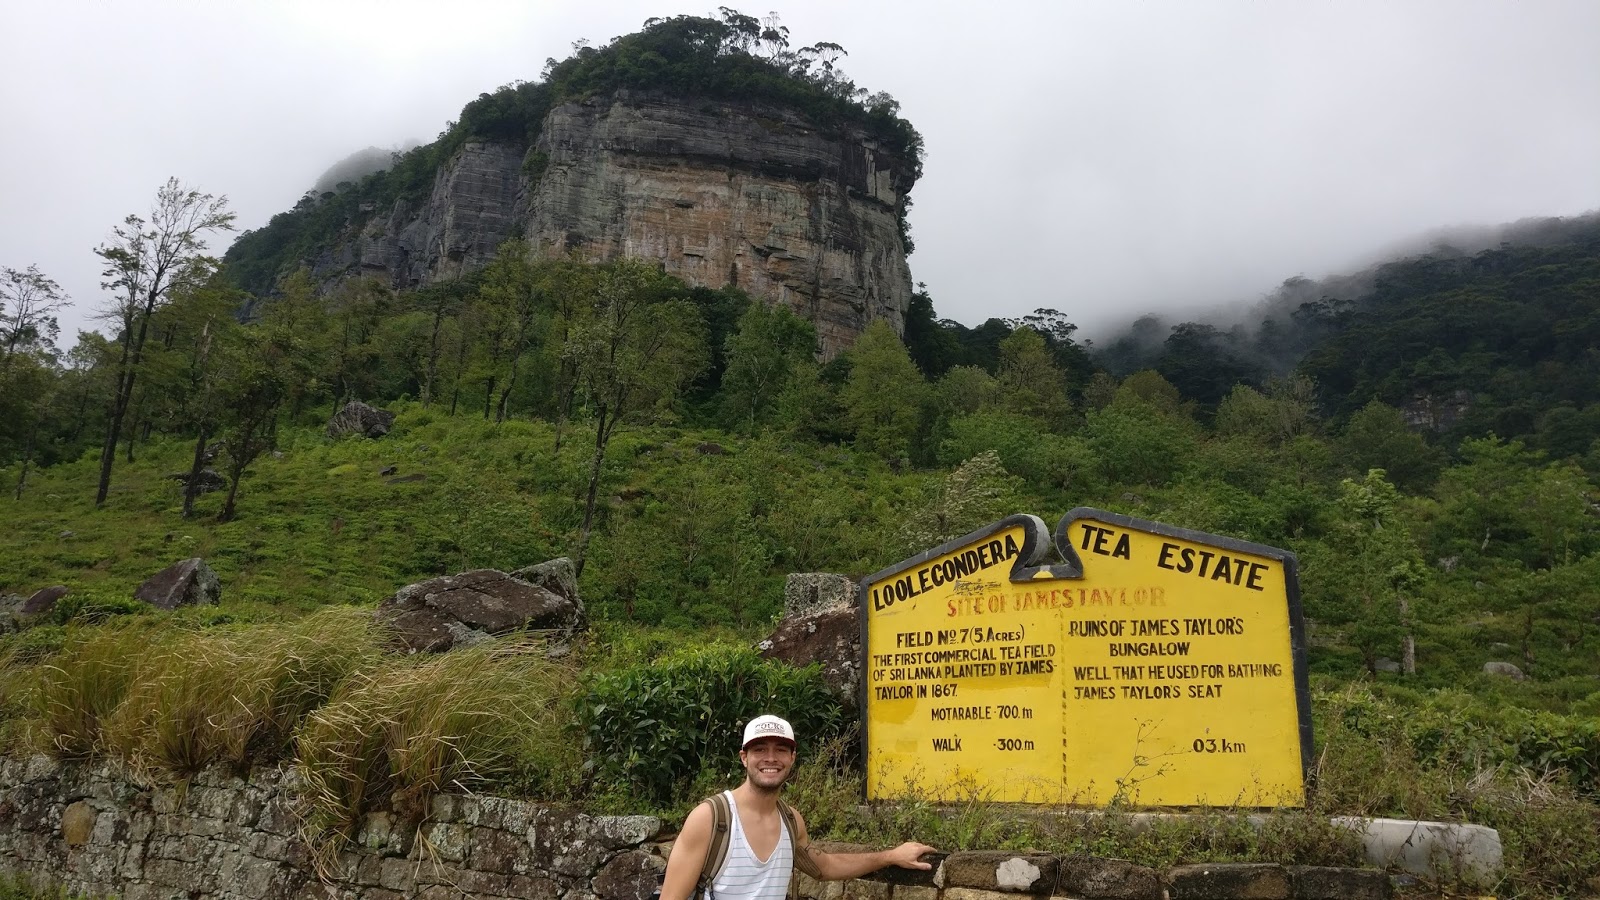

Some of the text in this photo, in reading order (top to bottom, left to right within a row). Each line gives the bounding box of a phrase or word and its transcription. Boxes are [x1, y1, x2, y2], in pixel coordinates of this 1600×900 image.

[873, 524, 1269, 611] LOOLECONDERA TEA ESTATE
[1013, 589, 1074, 612] JAMES
[1069, 617, 1244, 637] RUINS OF JAMES TAYLOR'S
[896, 631, 934, 648] FIELD
[874, 644, 1056, 667] THE FIRST COMMERCIAL TEA FIELD
[1109, 642, 1190, 657] BUNGALOW
[873, 669, 886, 682] OF
[890, 668, 905, 680] SRI
[907, 666, 942, 680] LANKA
[944, 663, 996, 679] PLANTED
[1000, 662, 1014, 675] BY
[1074, 663, 1282, 681] WELL THAT HE USED FOR BATHING
[875, 686, 913, 700] TAYLOR
[916, 685, 927, 698] IN
[1074, 684, 1222, 700] JAMES TAYLOR'S SEAT
[931, 706, 992, 721] MOTARABLE
[932, 738, 962, 752] WALK
